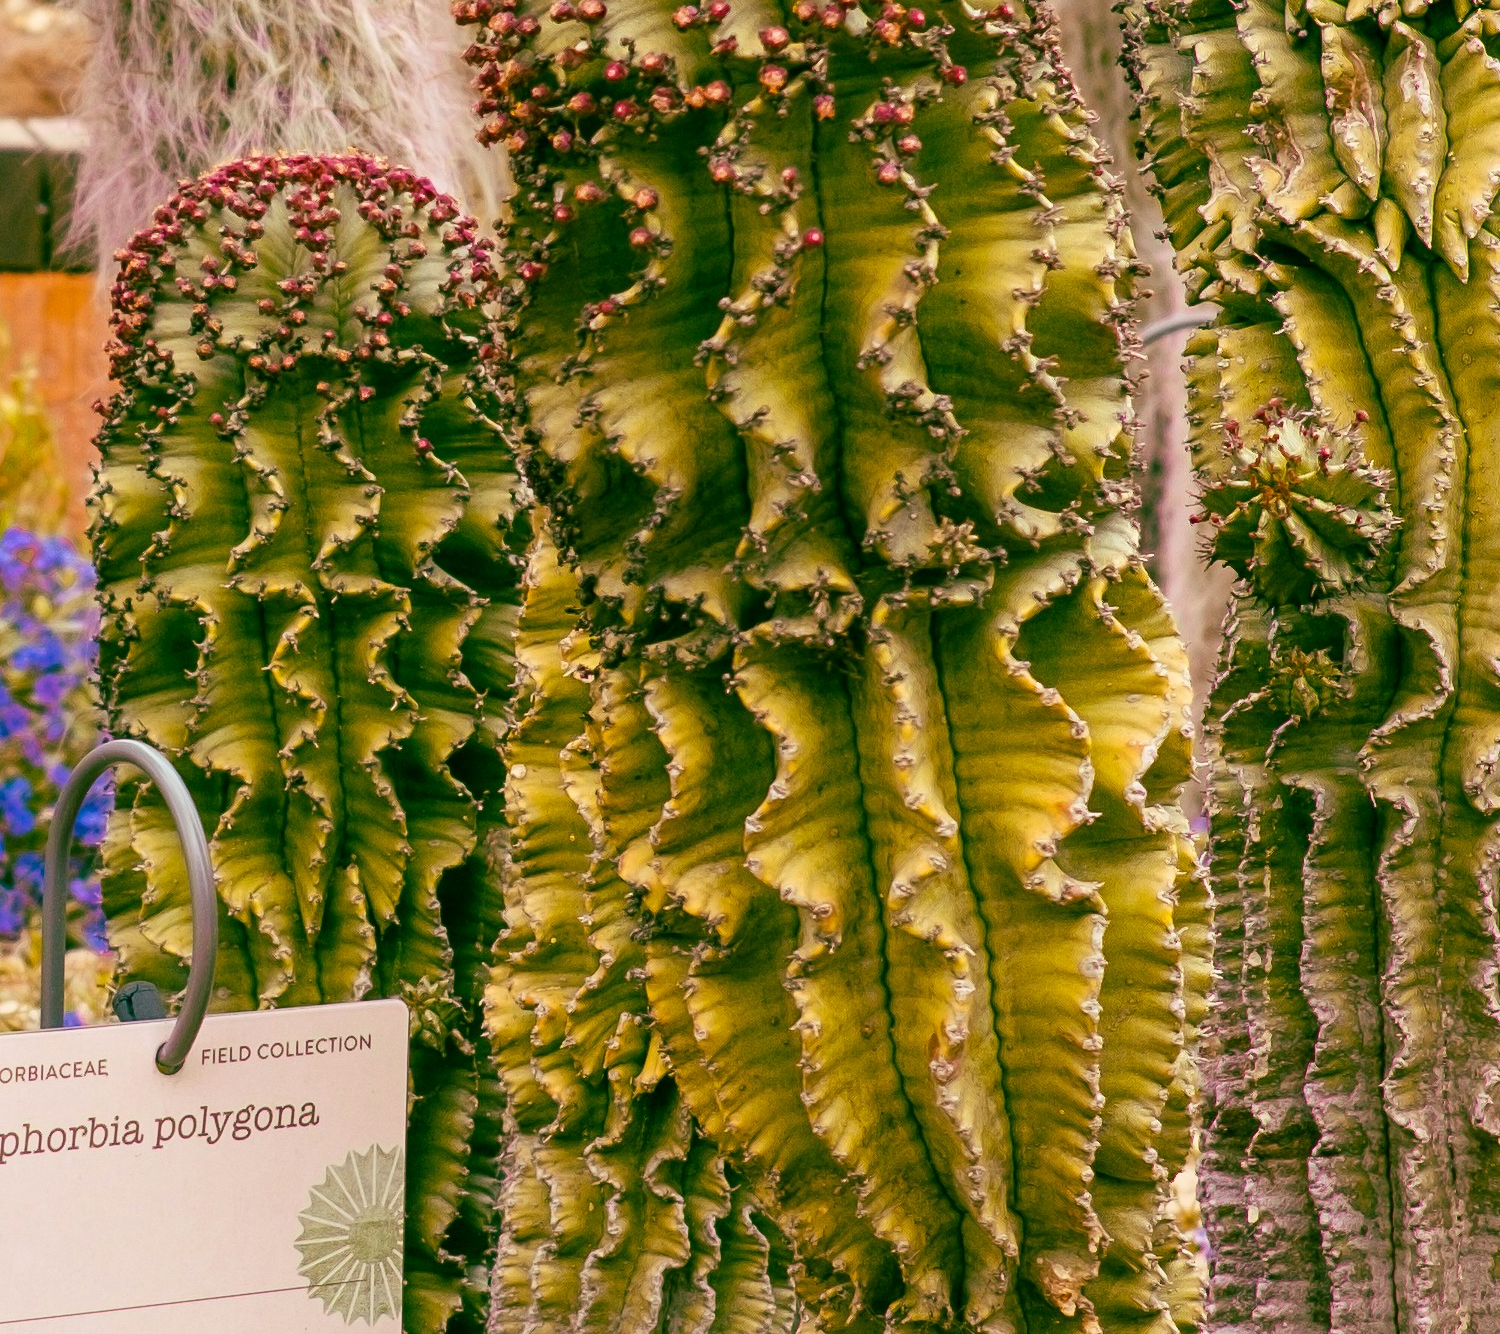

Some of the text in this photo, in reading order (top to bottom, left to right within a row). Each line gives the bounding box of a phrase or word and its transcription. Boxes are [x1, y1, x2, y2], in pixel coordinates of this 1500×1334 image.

[201, 1033, 373, 1066] FIELD COLLECTION
[152, 1100, 321, 1150] polygona
